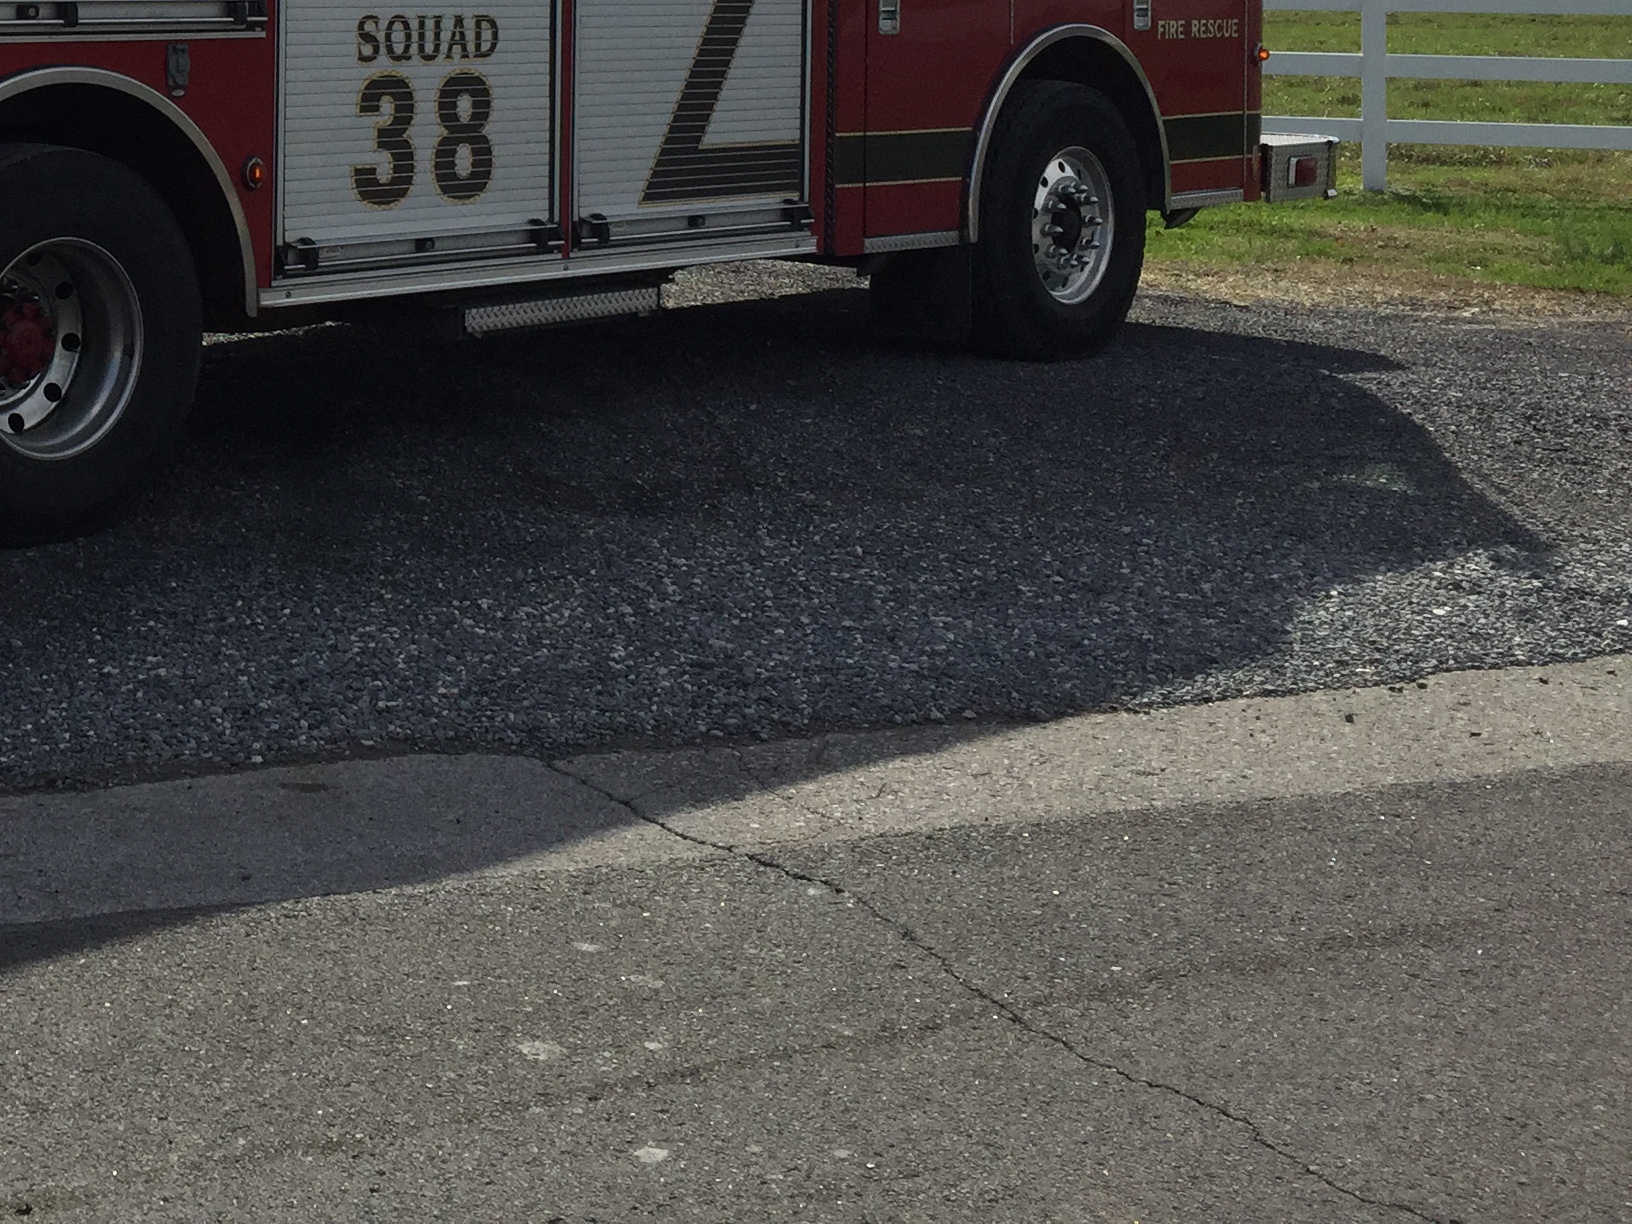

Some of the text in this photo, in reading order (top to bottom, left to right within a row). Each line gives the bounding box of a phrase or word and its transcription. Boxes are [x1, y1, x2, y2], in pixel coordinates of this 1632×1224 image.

[356, 14, 499, 62] SQUAD
[1157, 18, 1239, 40] FIRE RESCUE
[351, 68, 495, 209] 38
